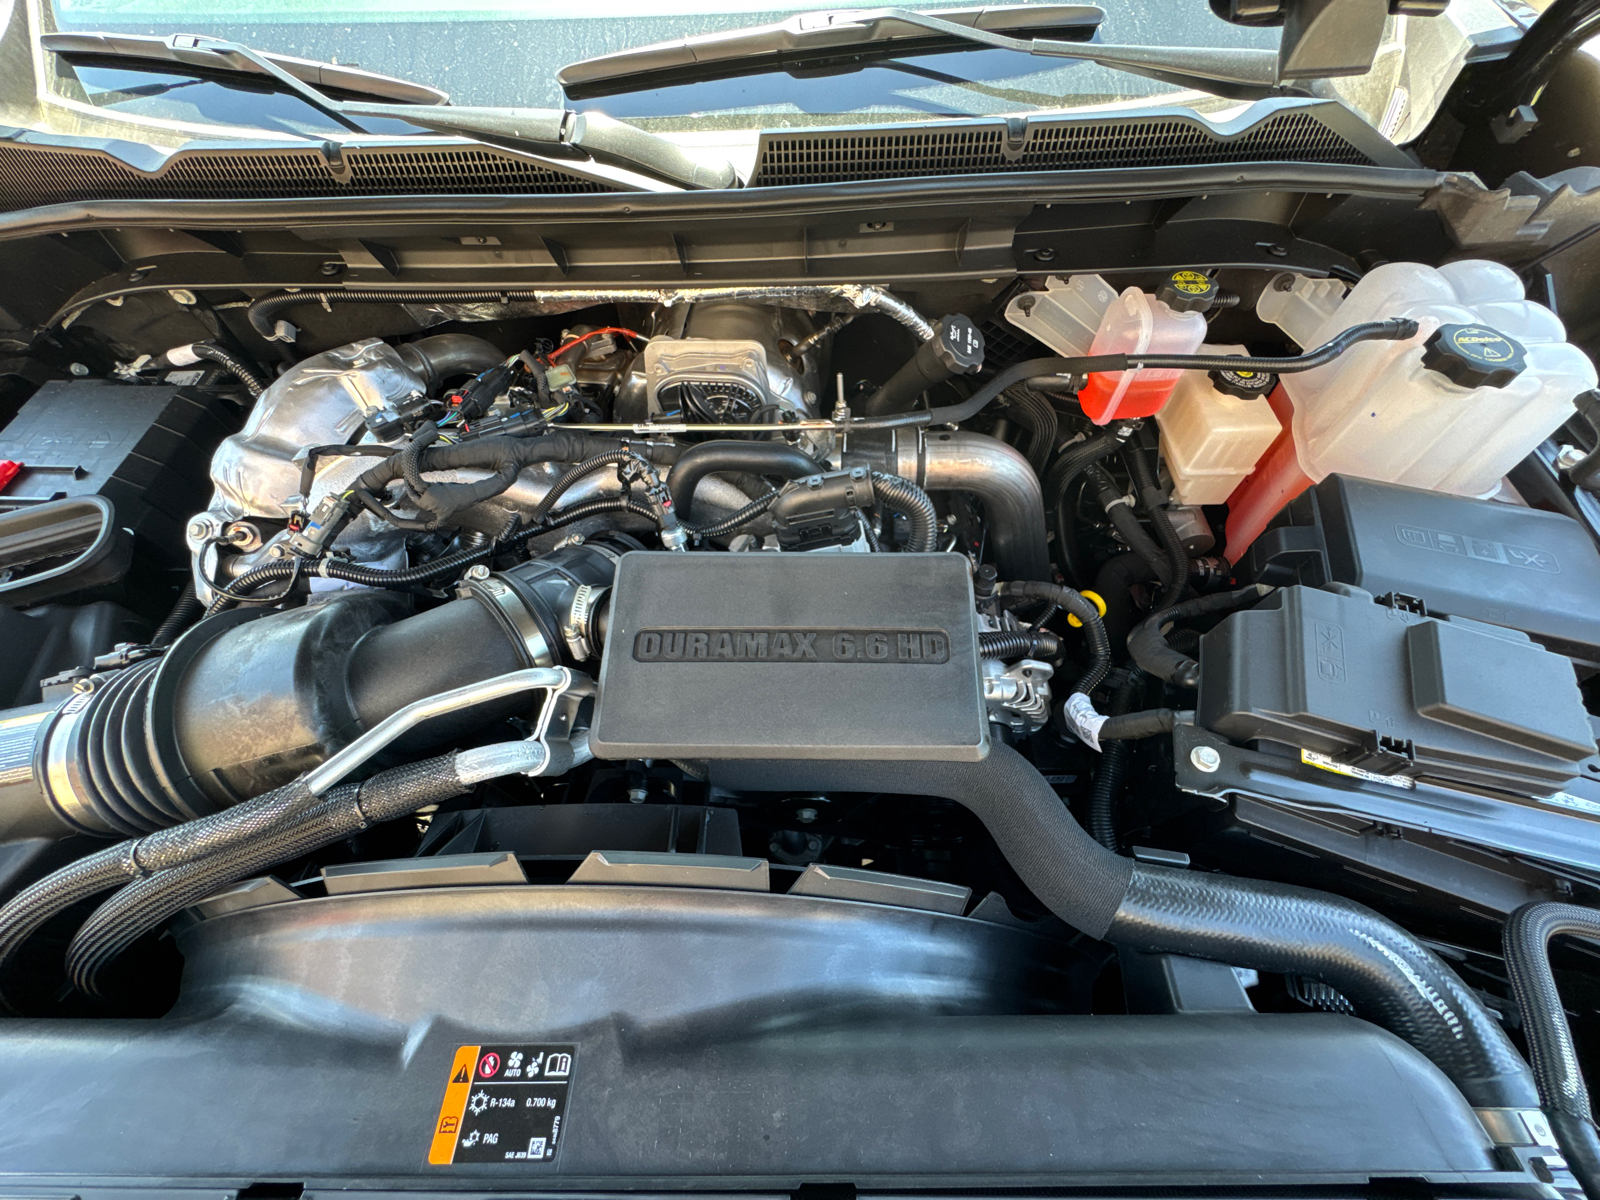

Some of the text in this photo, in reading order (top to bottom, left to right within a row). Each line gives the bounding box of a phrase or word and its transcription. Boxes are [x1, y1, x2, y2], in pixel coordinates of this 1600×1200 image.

[1457, 335, 1502, 343] ACDelco
[637, 632, 945, 660] DURAMAX 6.6 HD
[504, 1069, 521, 1077] AUTO
[490, 1097, 556, 1109] R-134a 0.700 kg
[482, 1133, 499, 1144] PAG
[505, 1151, 515, 1159] SAE
